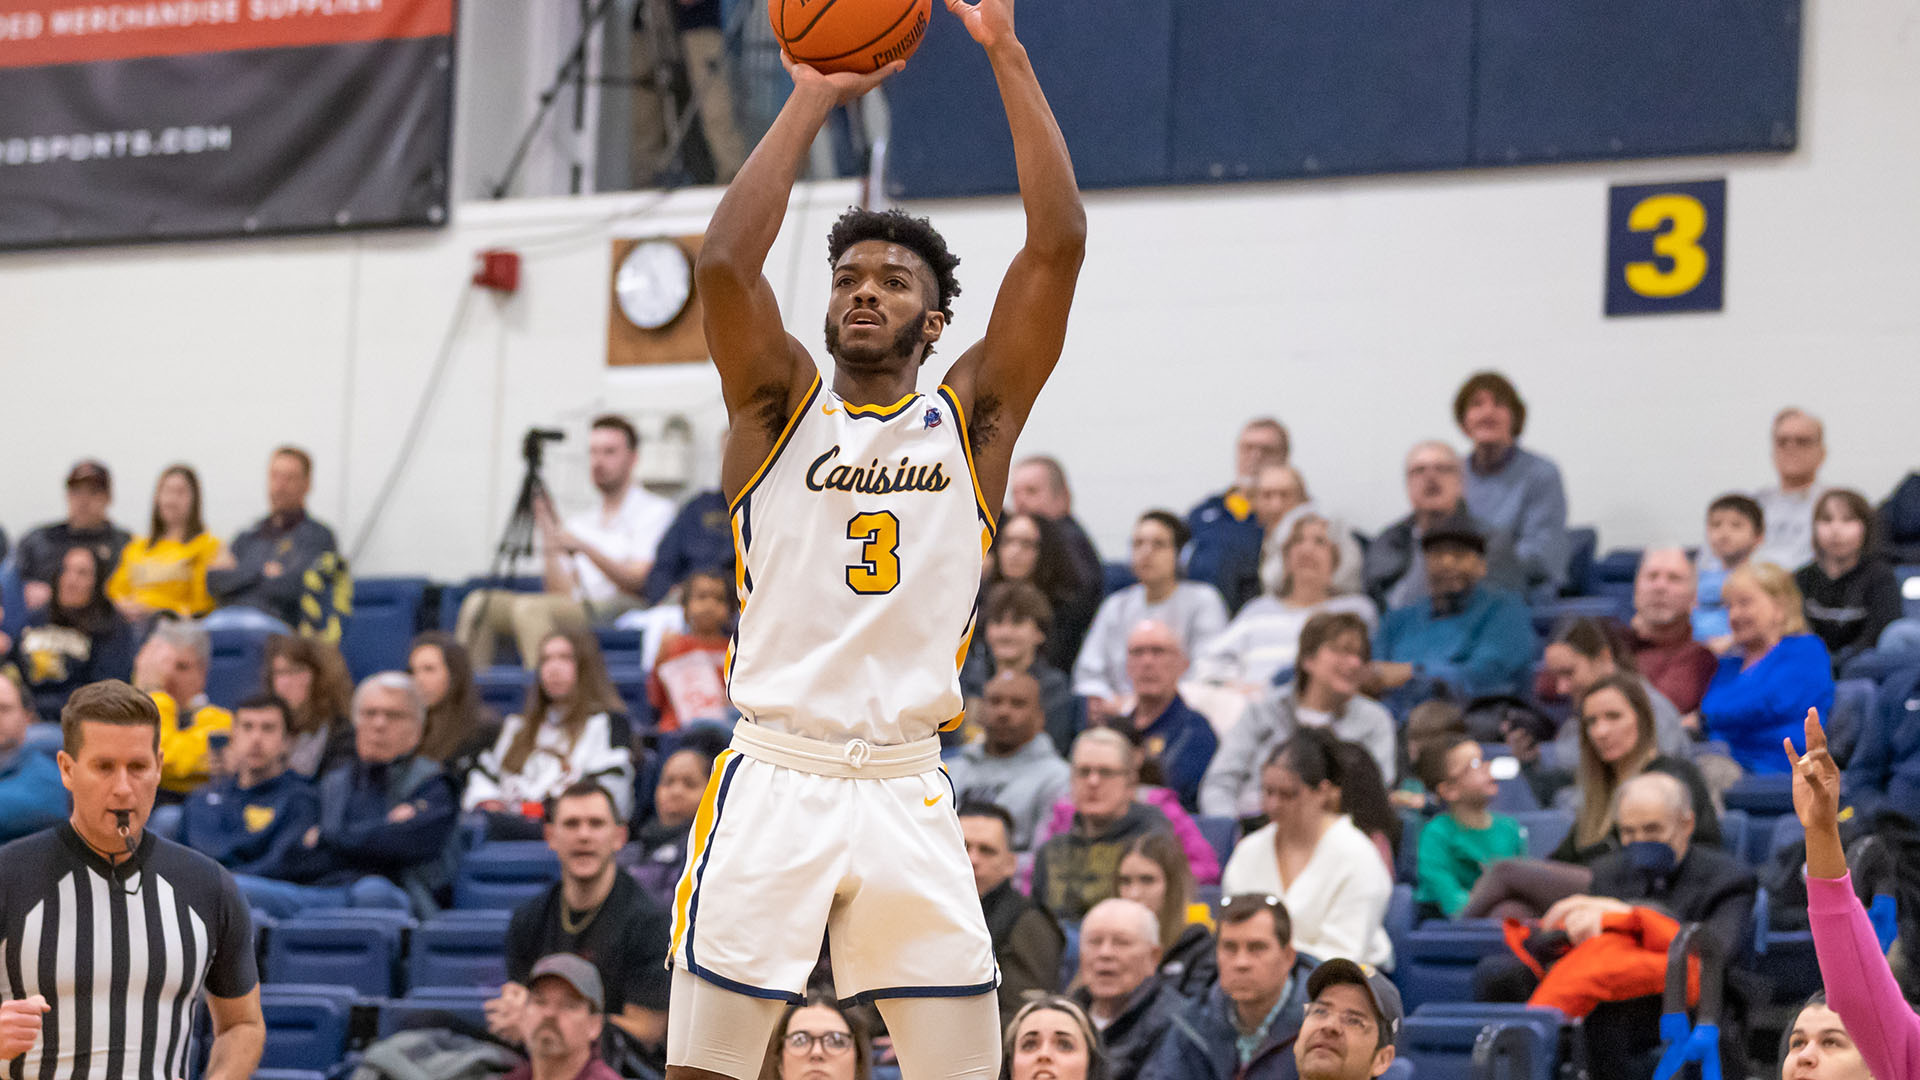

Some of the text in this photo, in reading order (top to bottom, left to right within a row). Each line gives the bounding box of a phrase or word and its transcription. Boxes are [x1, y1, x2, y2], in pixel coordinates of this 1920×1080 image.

[51, 0, 239, 36] MERCHANDISE
[1625, 194, 1709, 298] 3
[806, 445, 951, 494] Canisius
[846, 510, 900, 595] 3
